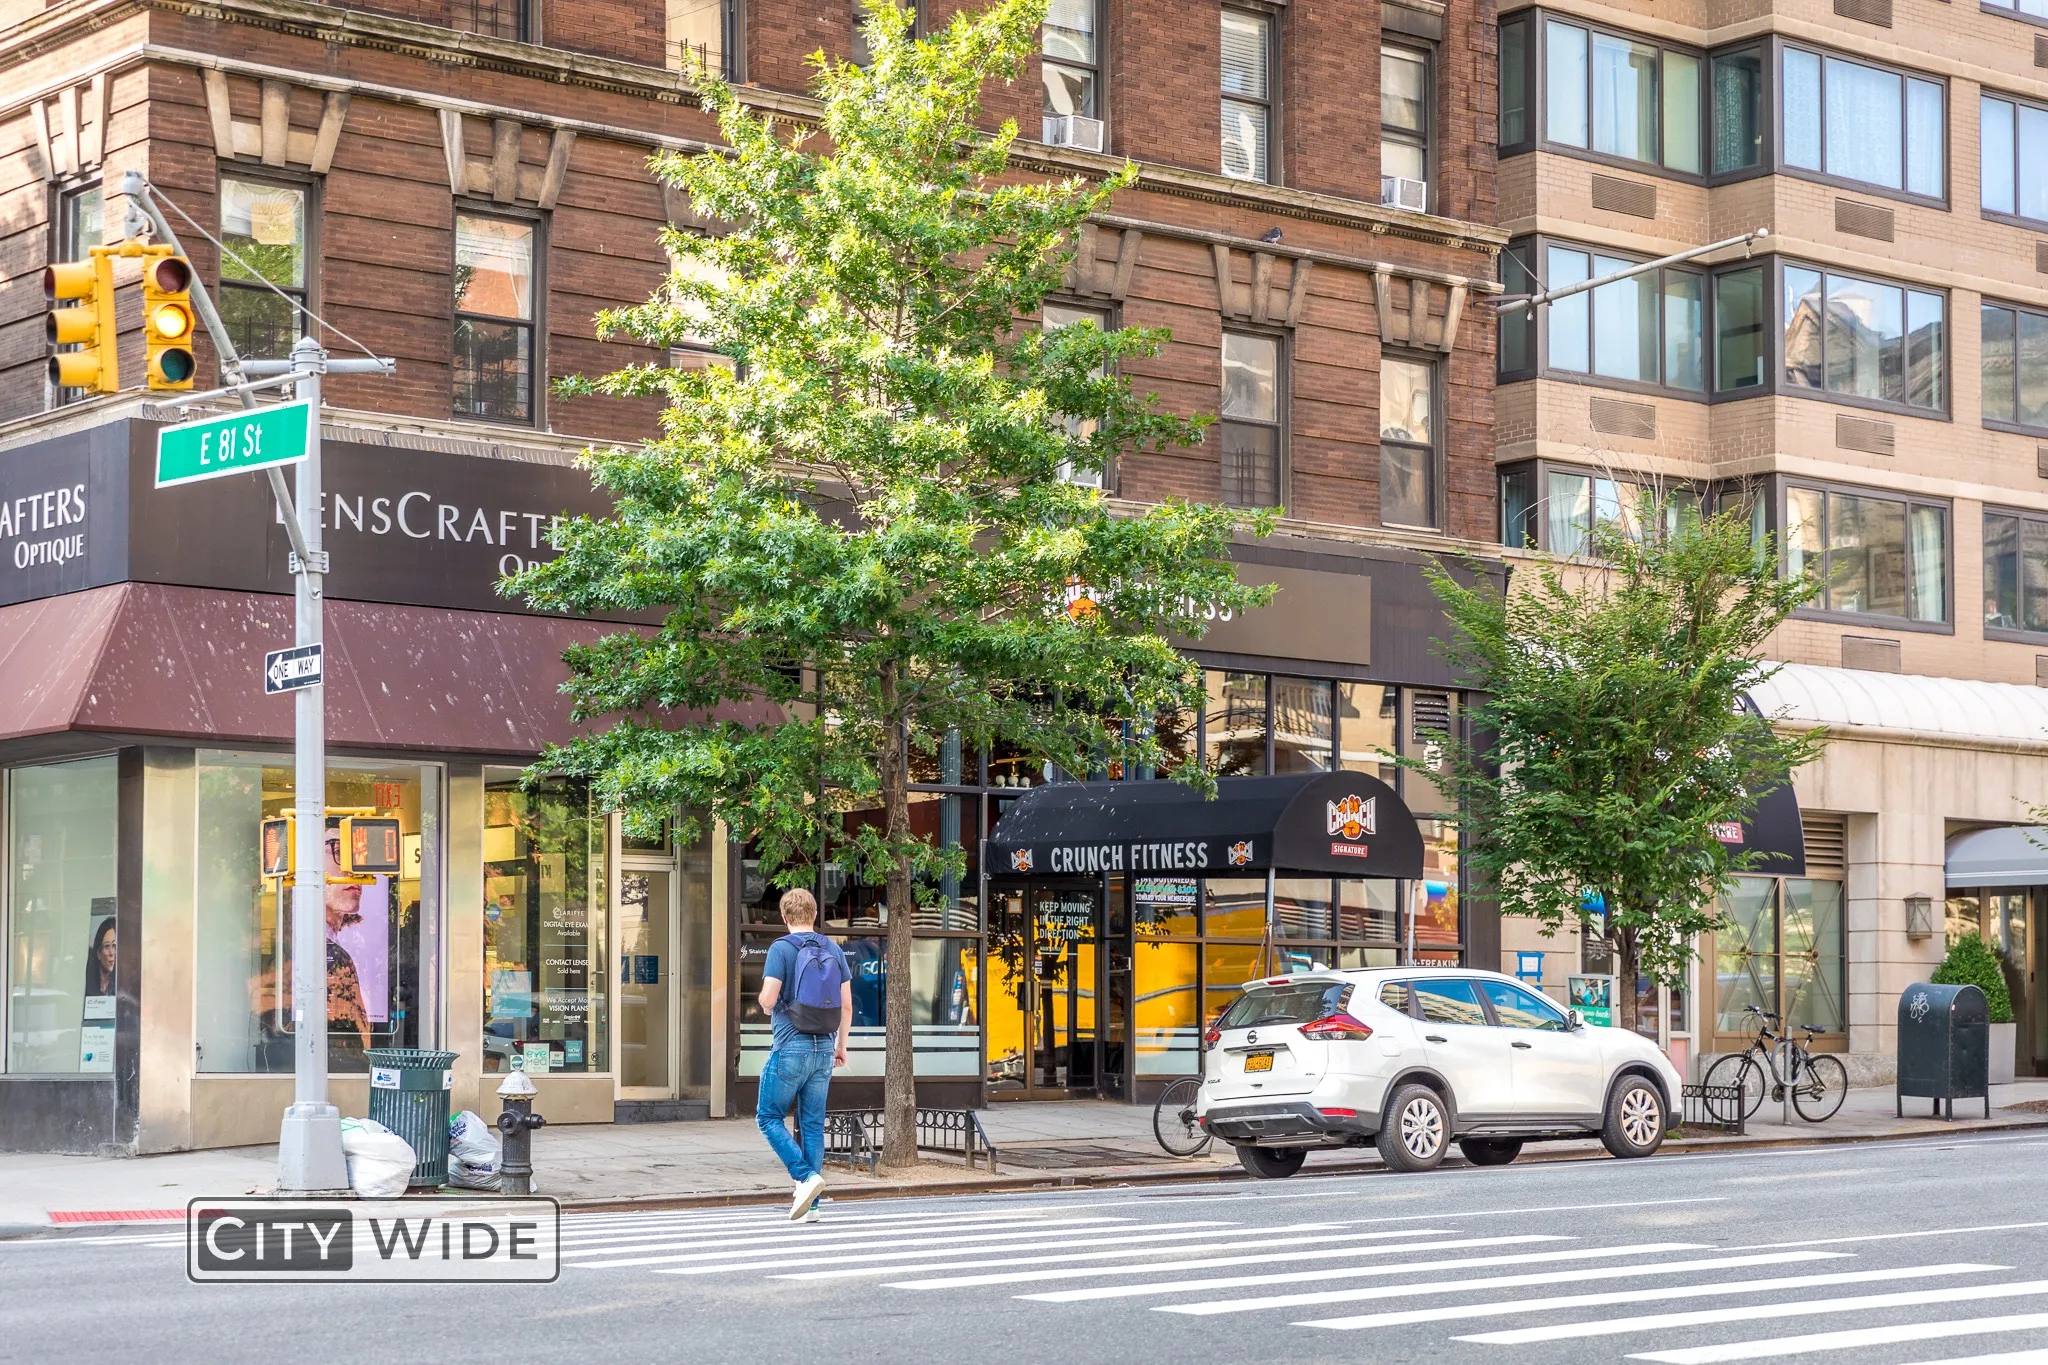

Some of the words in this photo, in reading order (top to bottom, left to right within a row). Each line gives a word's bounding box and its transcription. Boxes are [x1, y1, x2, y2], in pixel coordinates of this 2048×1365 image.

[200, 432, 212, 465] E
[219, 427, 236, 461] 81
[243, 422, 262, 457] St
[0, 484, 85, 538] AFTERS
[15, 534, 84, 568] OPTIQUE
[274, 663, 288, 680] ONE
[297, 658, 314, 675] WAY
[1327, 794, 1376, 839] CRUNCH
[1050, 846, 1124, 872] CRUNCH
[1131, 842, 1208, 870] FITNESS
[1334, 845, 1365, 855] SIGNATURE
[1040, 902, 1059, 912] KEEP
[1061, 902, 1090, 913] MOVING
[1050, 915, 1064, 926] THE
[1066, 916, 1089, 927] RIGHT
[1040, 929, 1079, 940] DIRECTION
[526, 1050, 547, 1058] eye
